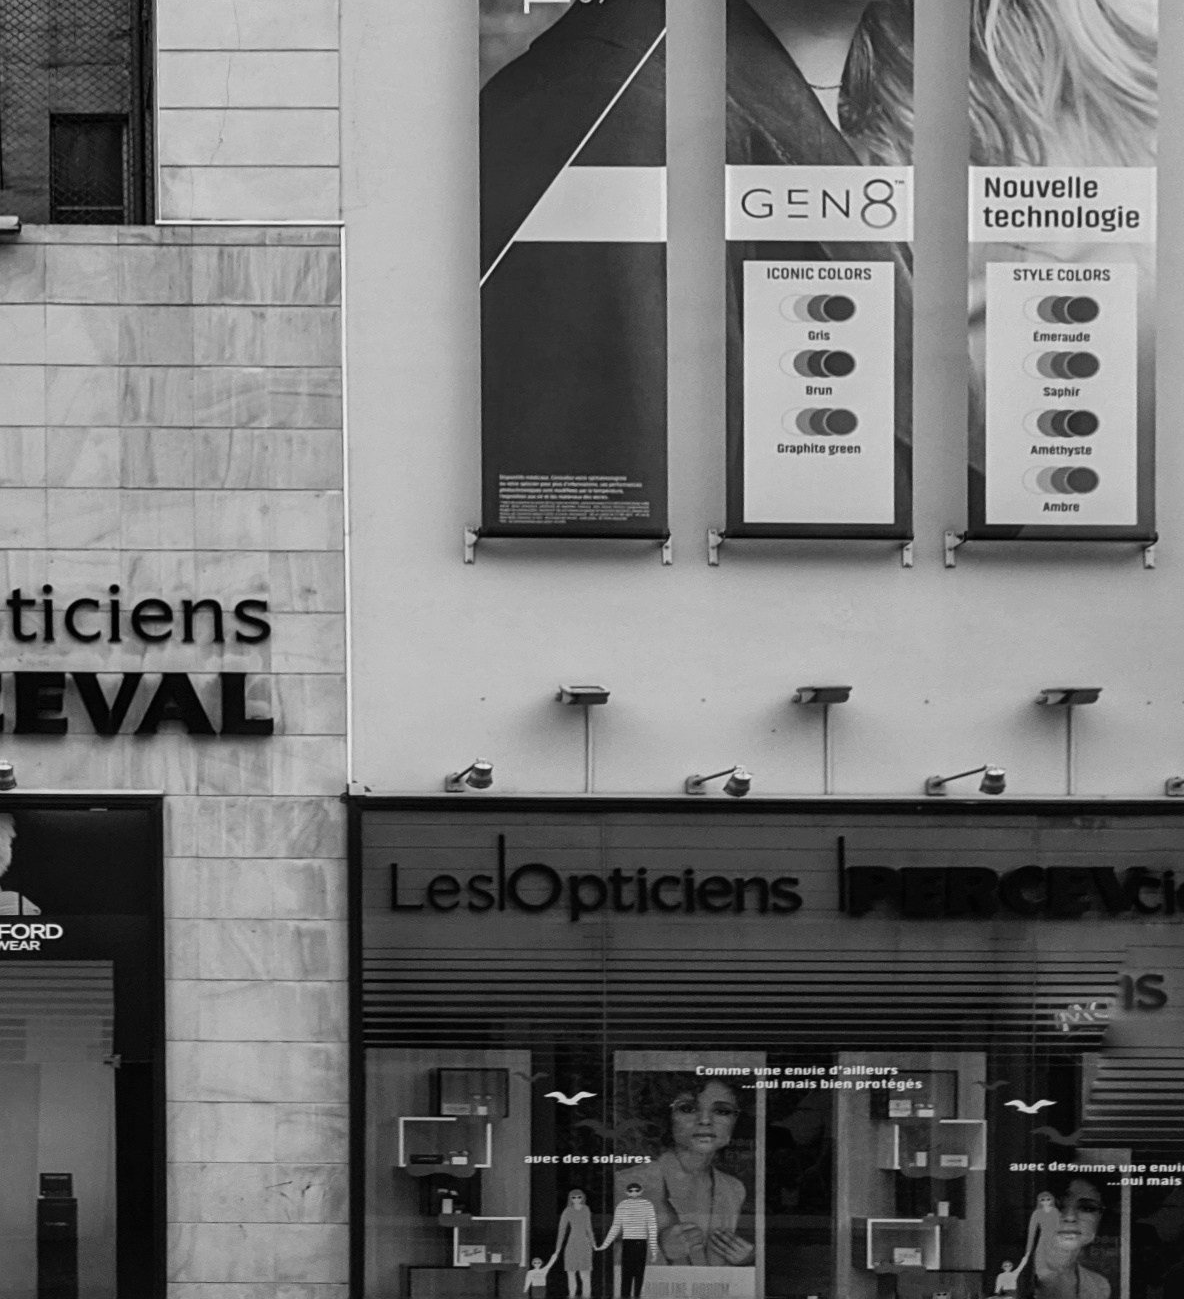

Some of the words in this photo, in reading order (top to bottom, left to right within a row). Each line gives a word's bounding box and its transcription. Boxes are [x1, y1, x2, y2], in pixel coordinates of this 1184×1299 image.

[984, 176, 1098, 199] Nouvelle
[740, 178, 898, 229] GEN8
[982, 205, 1140, 233] technologie
[766, 267, 814, 280] ICONIC
[817, 267, 872, 281] COLORS
[1013, 268, 1054, 282] STYLE
[1057, 268, 1111, 282] COLORS
[807, 330, 831, 341] Gris
[1033, 329, 1091, 343] Émeraude
[805, 385, 833, 396] Brun
[1043, 386, 1081, 398] Saphir
[777, 443, 826, 455] Graphite
[828, 444, 861, 456] green
[1030, 445, 1093, 457] Améthyste
[1042, 502, 1080, 513] Ambre
[389, 862, 495, 912] Les
[507, 862, 803, 922] Opticiens
[695, 1063, 751, 1076] Comme
[754, 1064, 782, 1076] une
[784, 1064, 826, 1076] envie
[828, 1064, 899, 1076] d'ailleurs
[742, 1077, 779, 1089] ...oui
[781, 1077, 817, 1089] mais
[820, 1077, 853, 1089] bien
[855, 1077, 923, 1091] protégés
[524, 1155, 560, 1164] avec
[562, 1154, 590, 1164] des
[592, 1154, 652, 1164] solaires
[1009, 1162, 1045, 1172] avec
[1119, 1163, 1147, 1173] une
[1106, 1176, 1144, 1186] ...oui
[1146, 1176, 1182, 1186] mais
